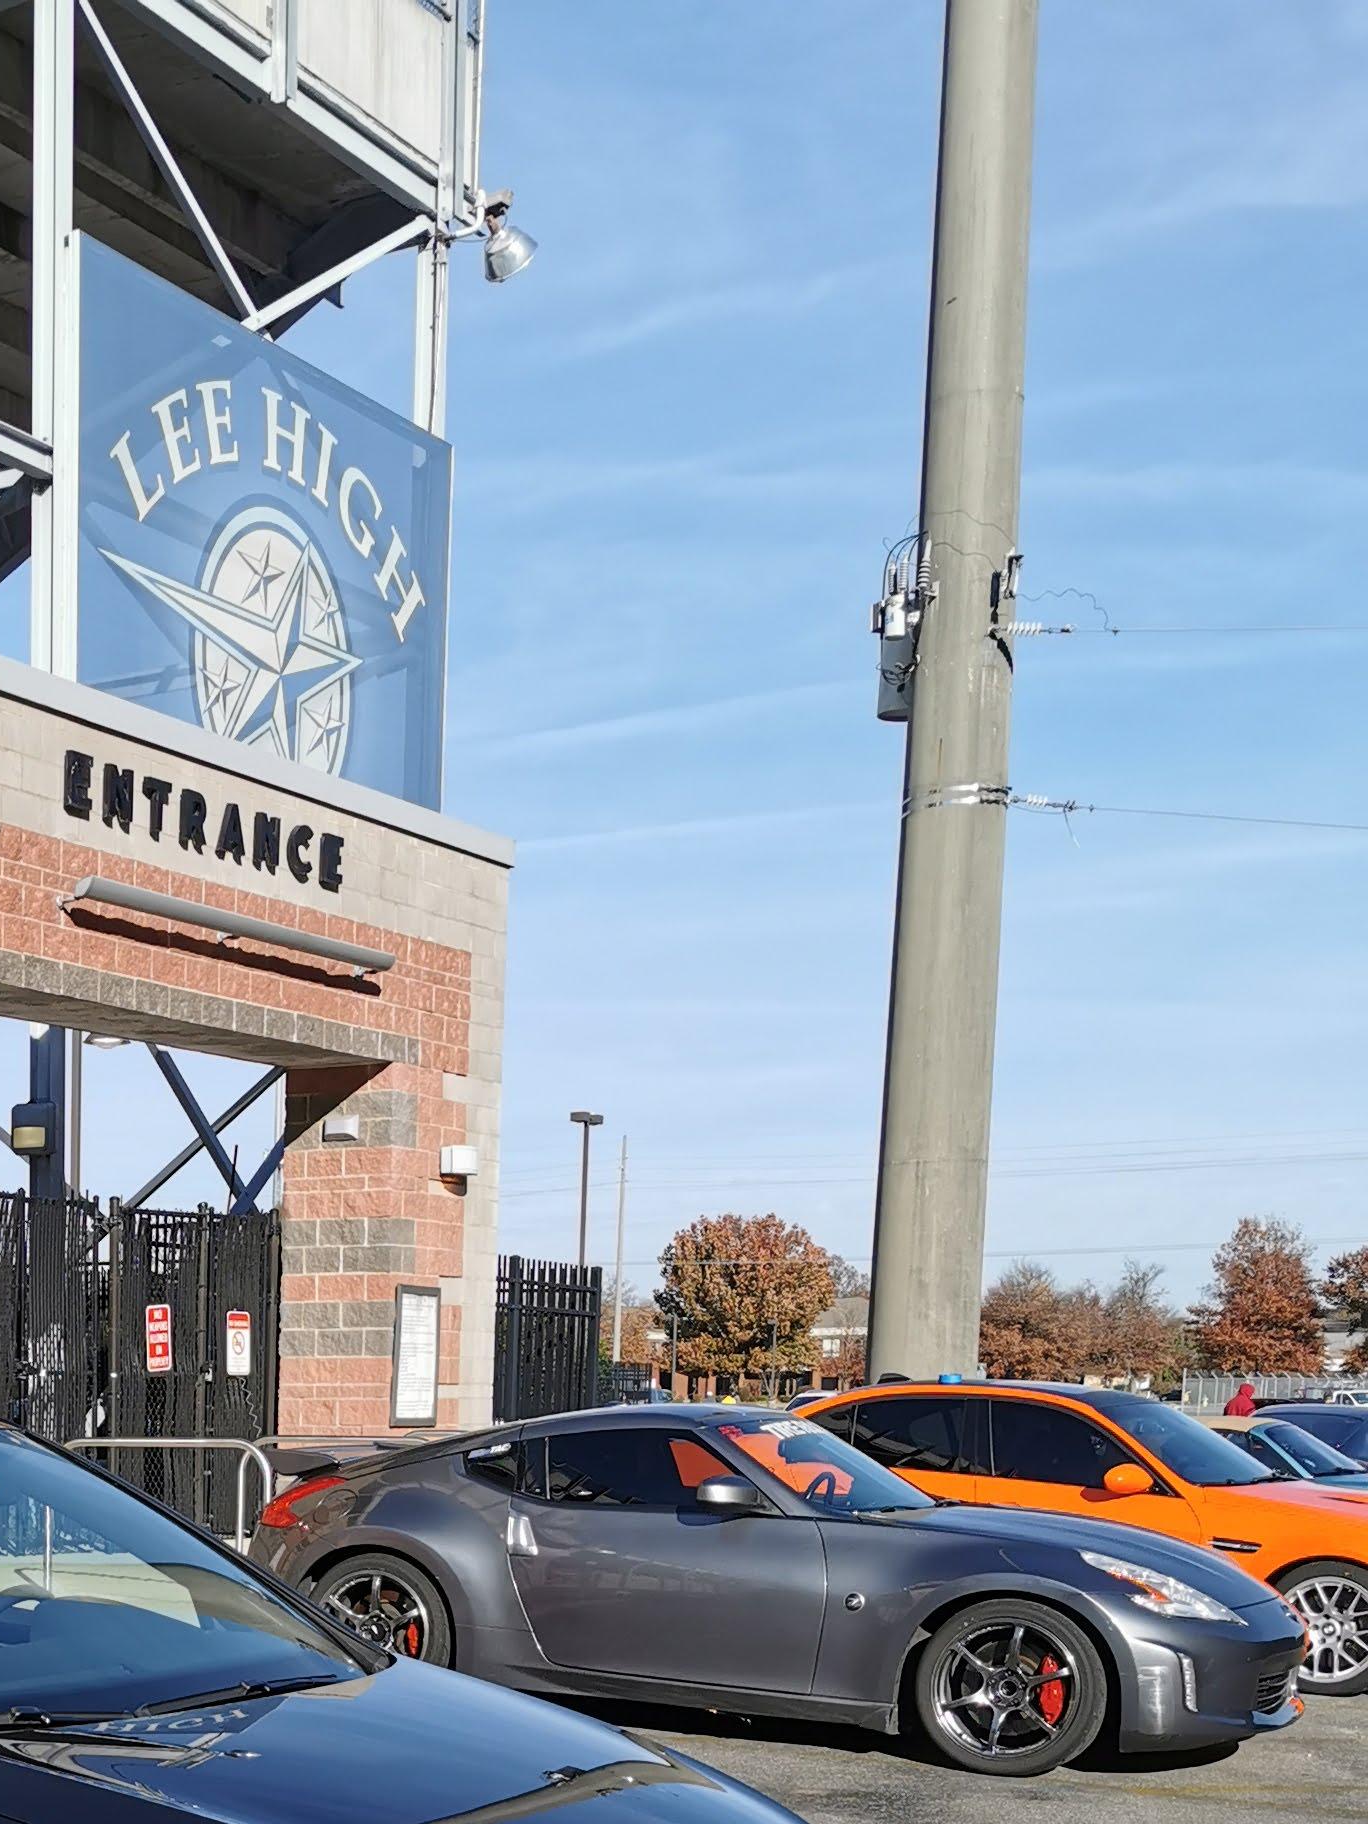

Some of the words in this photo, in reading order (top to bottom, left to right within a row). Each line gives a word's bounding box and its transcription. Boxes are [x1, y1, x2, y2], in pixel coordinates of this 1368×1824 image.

[109, 379, 240, 523] LEE
[260, 386, 427, 644] HIGH
[63, 749, 345, 893] ENTRANCE
